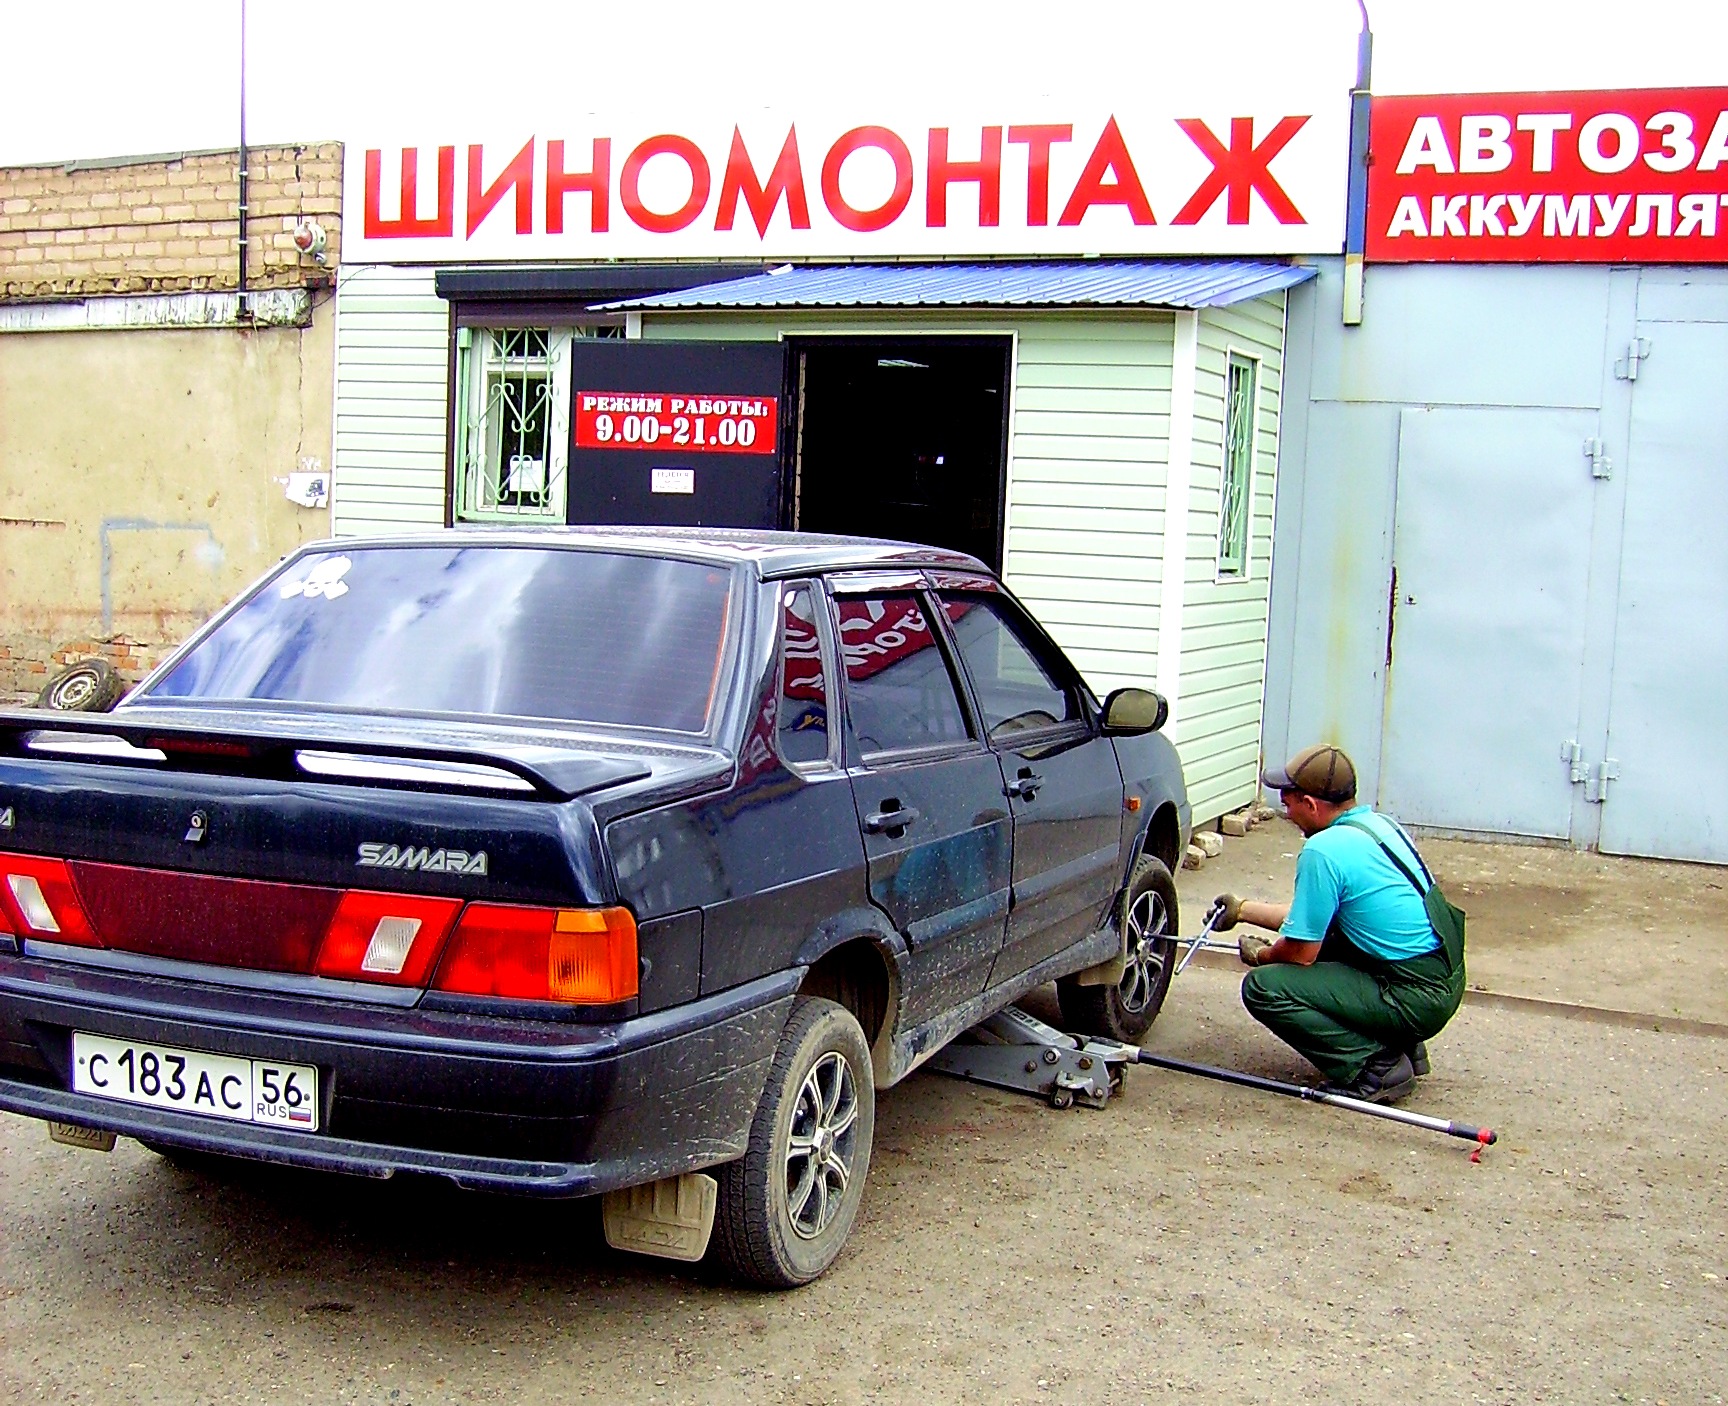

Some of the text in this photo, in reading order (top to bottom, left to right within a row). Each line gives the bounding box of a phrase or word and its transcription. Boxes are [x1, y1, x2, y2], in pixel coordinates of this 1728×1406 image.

[363, 115, 1311, 240] ШИНОМОНТАЖ
[1386, 193, 1728, 238] АККУМУЛЯ
[583, 396, 768, 417] РЕЖИМ РАБОТЫ:
[595, 414, 756, 446] 9.00-21.00
[356, 842, 488, 875] SAMARA
[261, 1068, 303, 1107] 56
[256, 1102, 287, 1119] RUS
